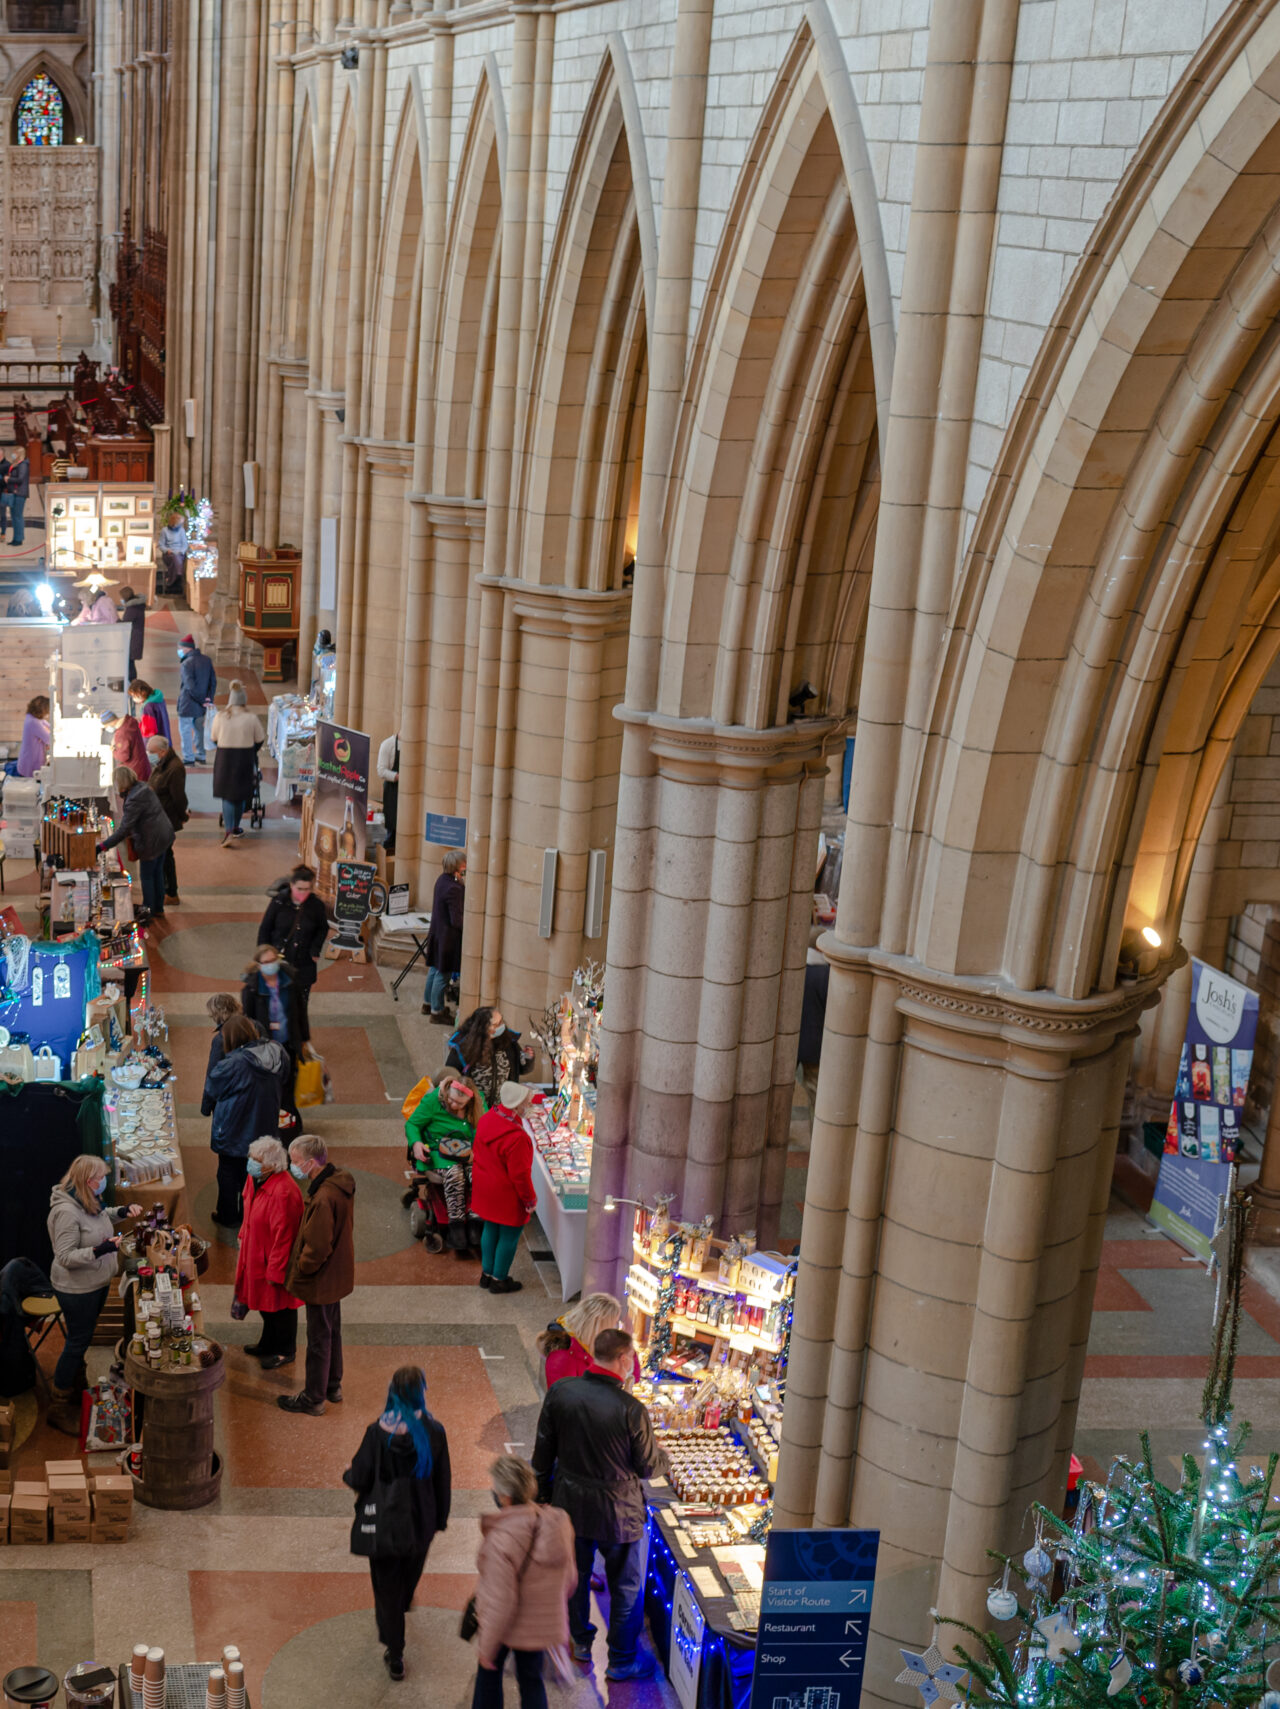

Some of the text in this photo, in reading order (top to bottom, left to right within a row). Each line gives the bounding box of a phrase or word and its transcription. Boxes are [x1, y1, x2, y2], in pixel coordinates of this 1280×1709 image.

[1202, 981, 1237, 1015] Josh's
[768, 1586, 807, 1596] Start of
[767, 1597, 831, 1606] Visitor Route
[764, 1623, 816, 1632] Restaurant
[760, 1653, 787, 1665] Shop
